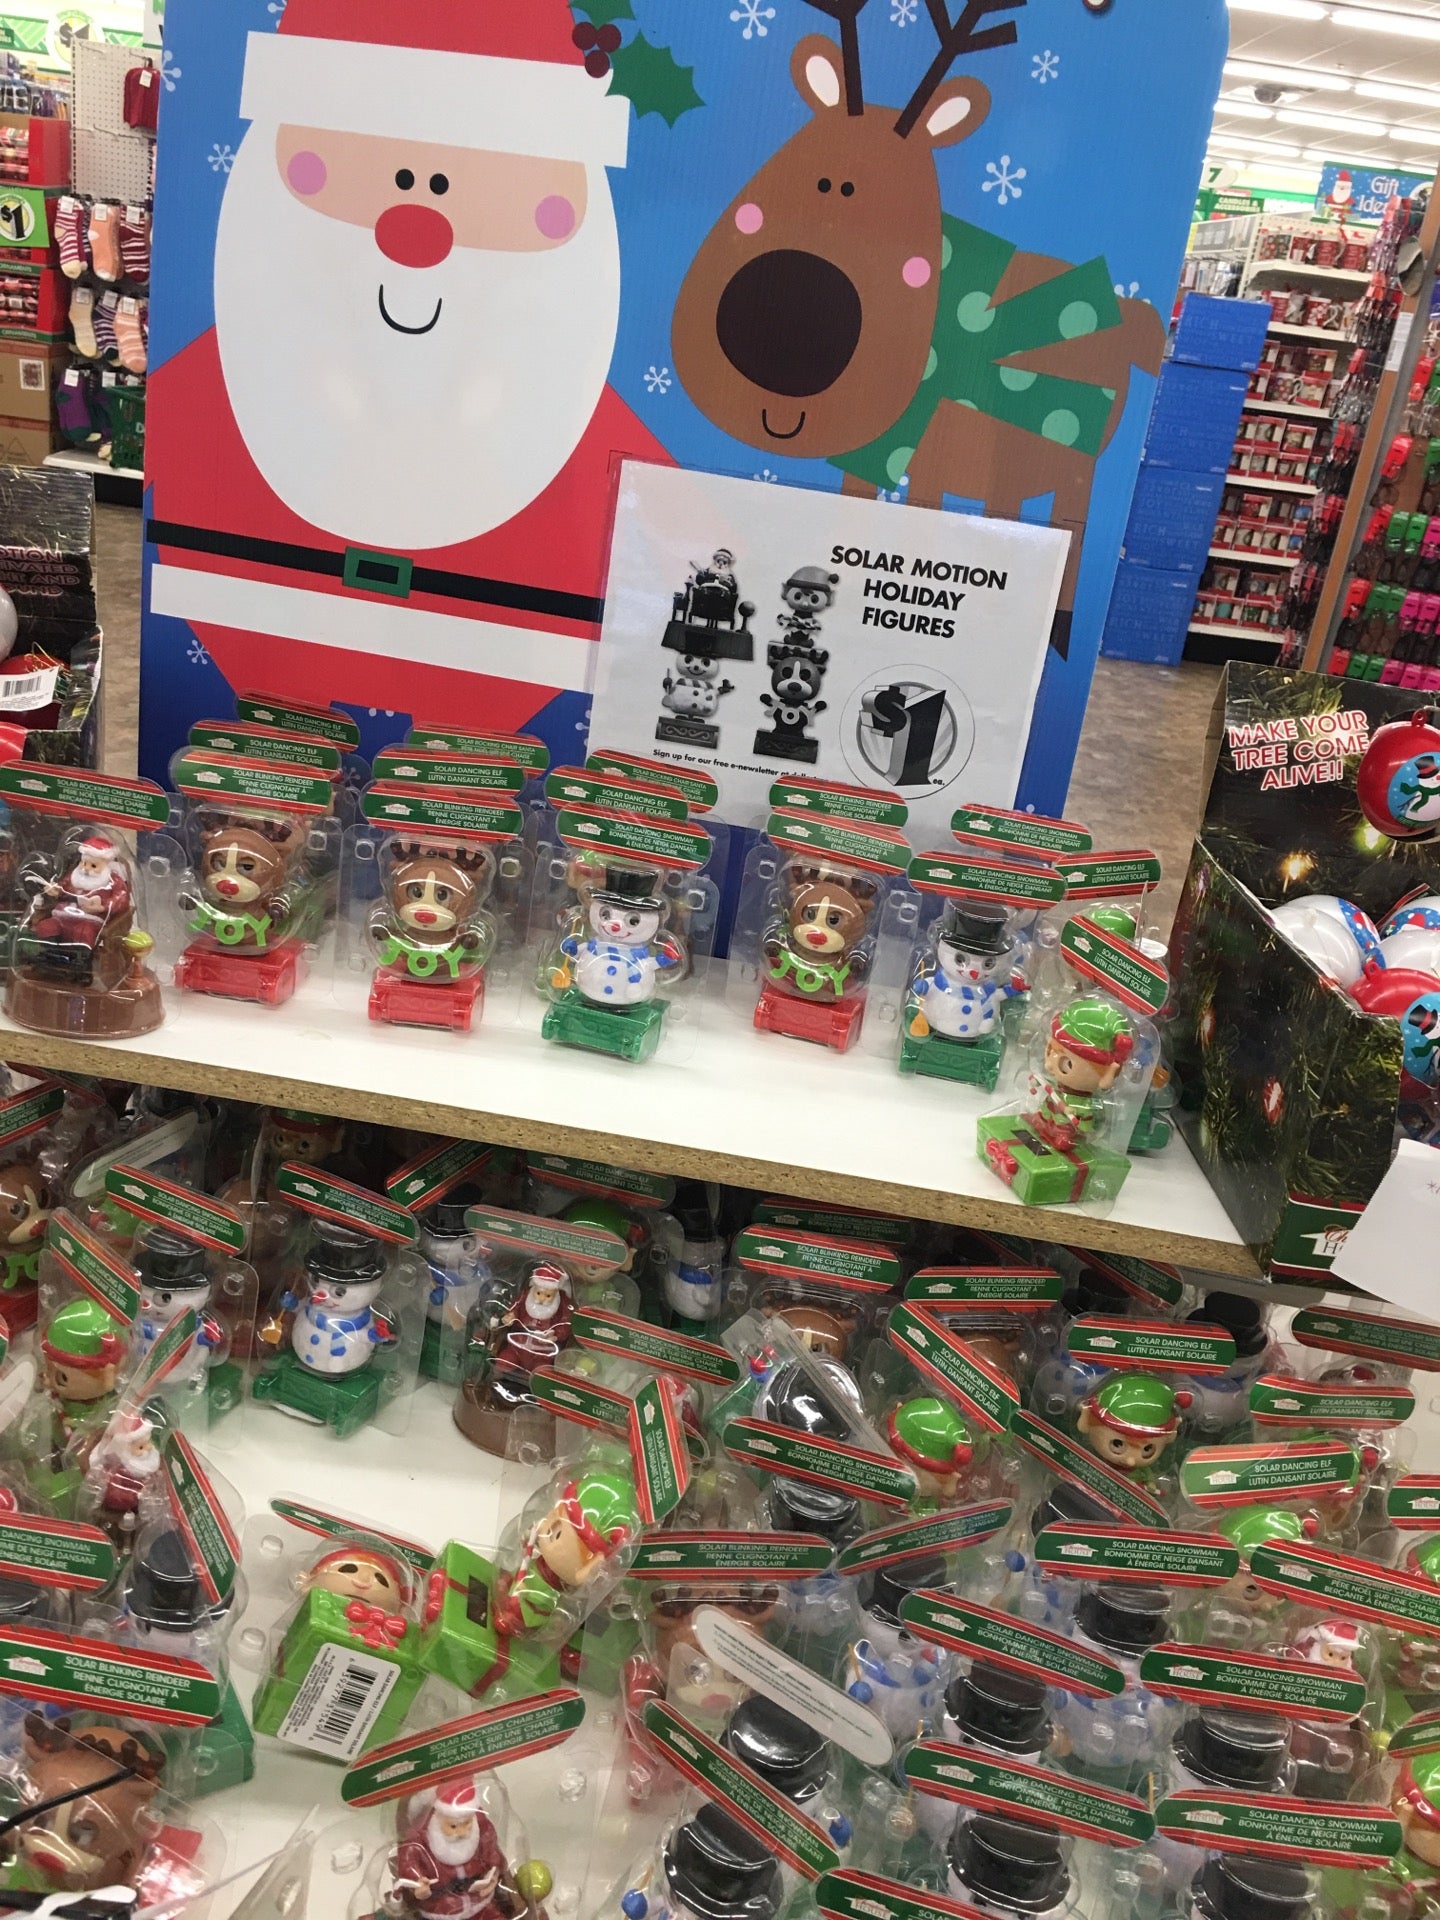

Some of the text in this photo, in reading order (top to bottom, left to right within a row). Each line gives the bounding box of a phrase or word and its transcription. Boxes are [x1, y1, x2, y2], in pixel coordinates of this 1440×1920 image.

[1208, 167, 1222, 183] 7
[1371, 176, 1399, 198] Gift
[0, 203, 26, 239] $1
[830, 545, 1008, 590] SOLAR MOTION
[863, 578, 966, 611] HOLIDAY
[862, 606, 956, 638] FIGURES
[859, 685, 946, 786] $1
[1229, 710, 1370, 748] MAKE YOUR
[1232, 733, 1371, 771] TREE COME
[434, 765, 502, 777] SOLAR DANCING ELF
[653, 749, 671, 759] Sign
[672, 753, 683, 761] up
[684, 753, 696, 762] for
[713, 759, 729, 769] free
[730, 763, 779, 777] e-newsletter
[233, 770, 314, 786] SOLAR BLINKING REINDEER
[428, 774, 508, 786] LUTIN DANSANT SOLAIRE
[933, 778, 945, 786] ea.
[1261, 761, 1344, 791] ALIVE!!
[238, 779, 260, 788] RENNE
[261, 782, 301, 794] CLIGNOTANT
[272, 790, 298, 800] SOLAIRE
[595, 797, 672, 817] LUTIN DANSANT SOLAIRE
[602, 789, 669, 806] SOLAR DANCING ELF
[422, 802, 505, 817] SOLAR BLINKING REINDEER
[427, 810, 450, 819] RENNE
[450, 812, 491, 823] CLIGNOTANT
[463, 820, 489, 829] SOLAIRE
[961, 875, 1053, 895] BONHOMME DE NEIGE DANSANT
[968, 866, 1050, 885] SOLAR DANCING SNOWMAN
[1009, 886, 1033, 896] SOLAIRE
[378, 937, 465, 982] JOY
[1101, 948, 1152, 984] SOLAR DANCING ELF
[771, 949, 852, 996] JOY
[1093, 956, 1152, 998] LUTIN DANSANT SOLAIRE
[1135, 1337, 1213, 1350] SOLAR DANCING ELF
[1127, 1346, 1218, 1361] LUTIN DANSANT SOLAIRE
[941, 1347, 1000, 1400] SOLAR DANCING ELF
[931, 1352, 999, 1415] LUTIN DANSANT SOLAIRE
[1255, 1460, 1331, 1473] SOLAR DANCING ELF
[1249, 1476, 1270, 1486] LUTIN
[1270, 1473, 1306, 1484] DANSANT
[1306, 1470, 1337, 1481] SOLAIRE
[1112, 1541, 1219, 1557] SOLAR DANCING SNOWMAN
[1104, 1551, 1224, 1568] BONHOMME DE NEIGE DANSANT
[1167, 1563, 1198, 1572] SOLAIRE
[65, 1656, 192, 1688] SOLAR BLINKING REINDEER
[73, 1671, 108, 1686] RENNE
[108, 1678, 171, 1697] CLIGNOTANT
[127, 1690, 167, 1706] SOLAIRE
[1249, 1810, 1379, 1831] SOLAR DANCING SNOWMAN
[1238, 1819, 1384, 1844] BONHOMME DE NEIGE DANSANT
[1314, 1838, 1352, 1850] SOLAIRE
